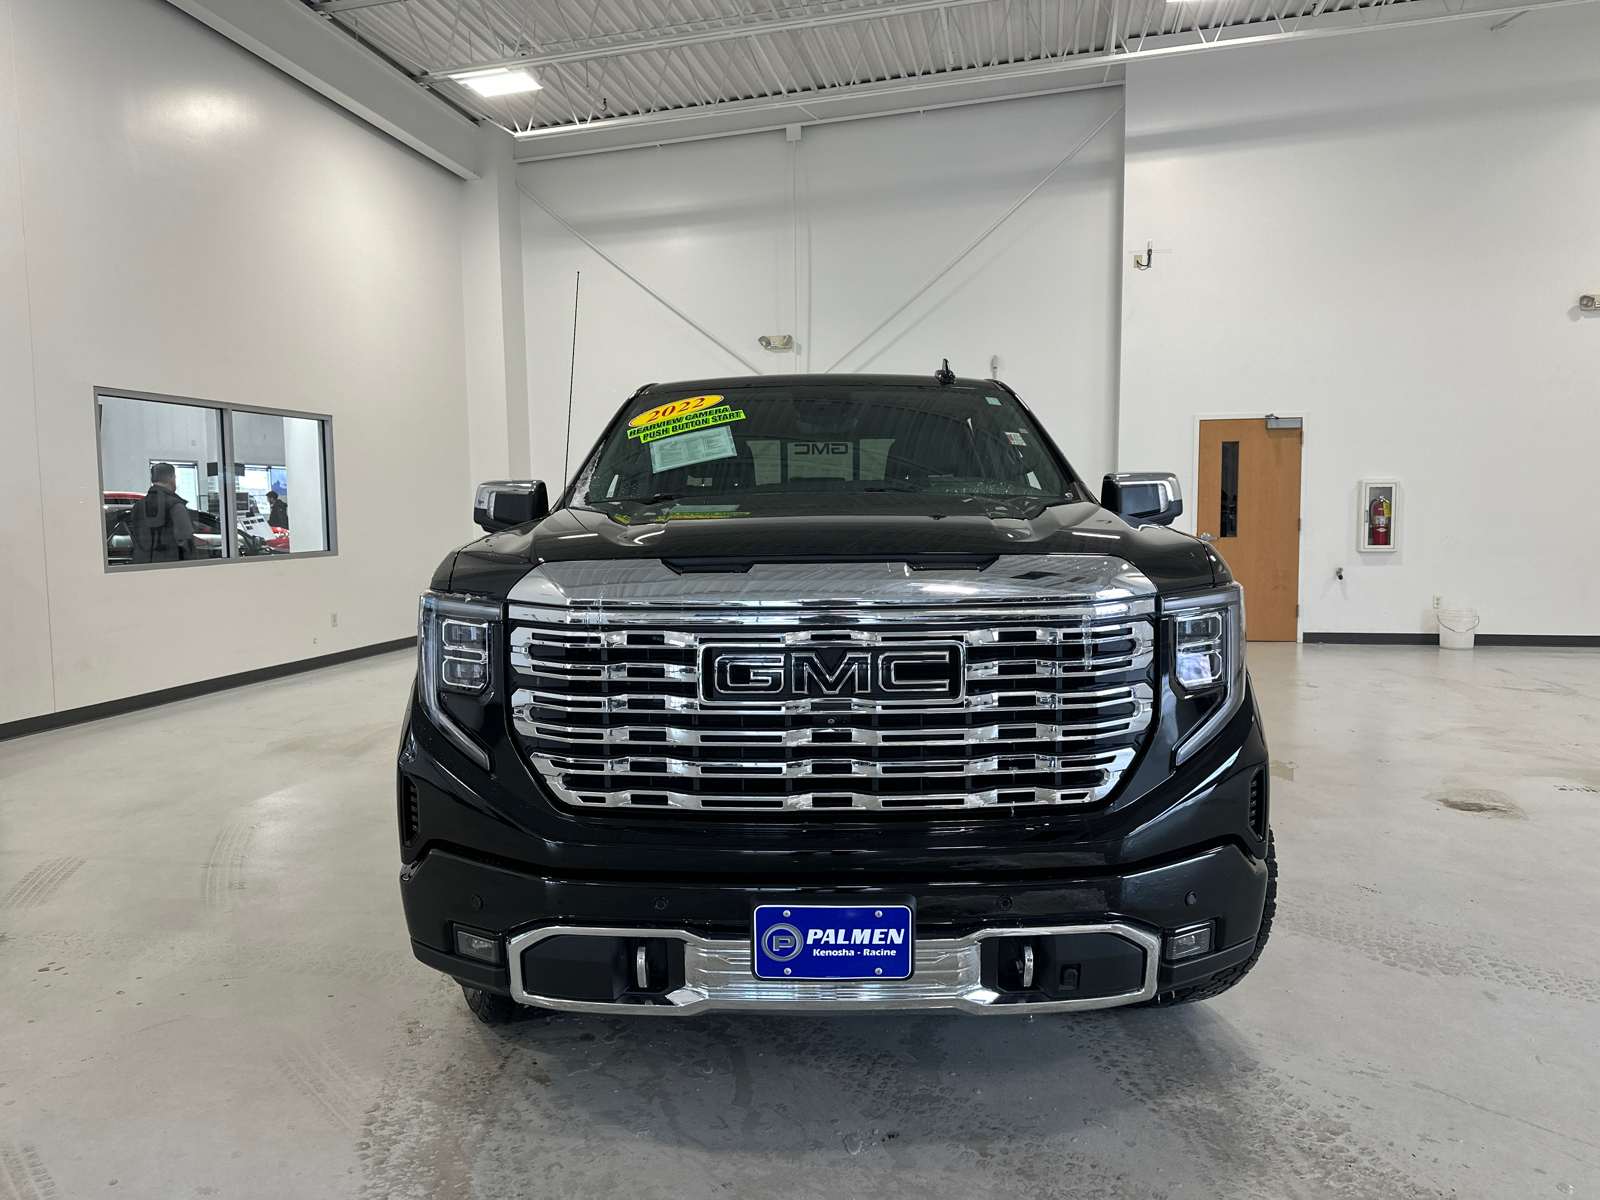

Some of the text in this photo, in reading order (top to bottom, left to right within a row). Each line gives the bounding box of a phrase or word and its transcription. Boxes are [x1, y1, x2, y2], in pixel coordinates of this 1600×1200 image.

[628, 407, 729, 437] REARVIEW CAMERA
[647, 397, 705, 423] 2022
[643, 411, 741, 441] PUSH BUTTON START
[714, 650, 950, 695] GMC
[772, 935, 796, 952] P
[806, 928, 905, 945] PALMEN
[813, 948, 855, 957] Kenosha
[863, 948, 897, 957] Racine
